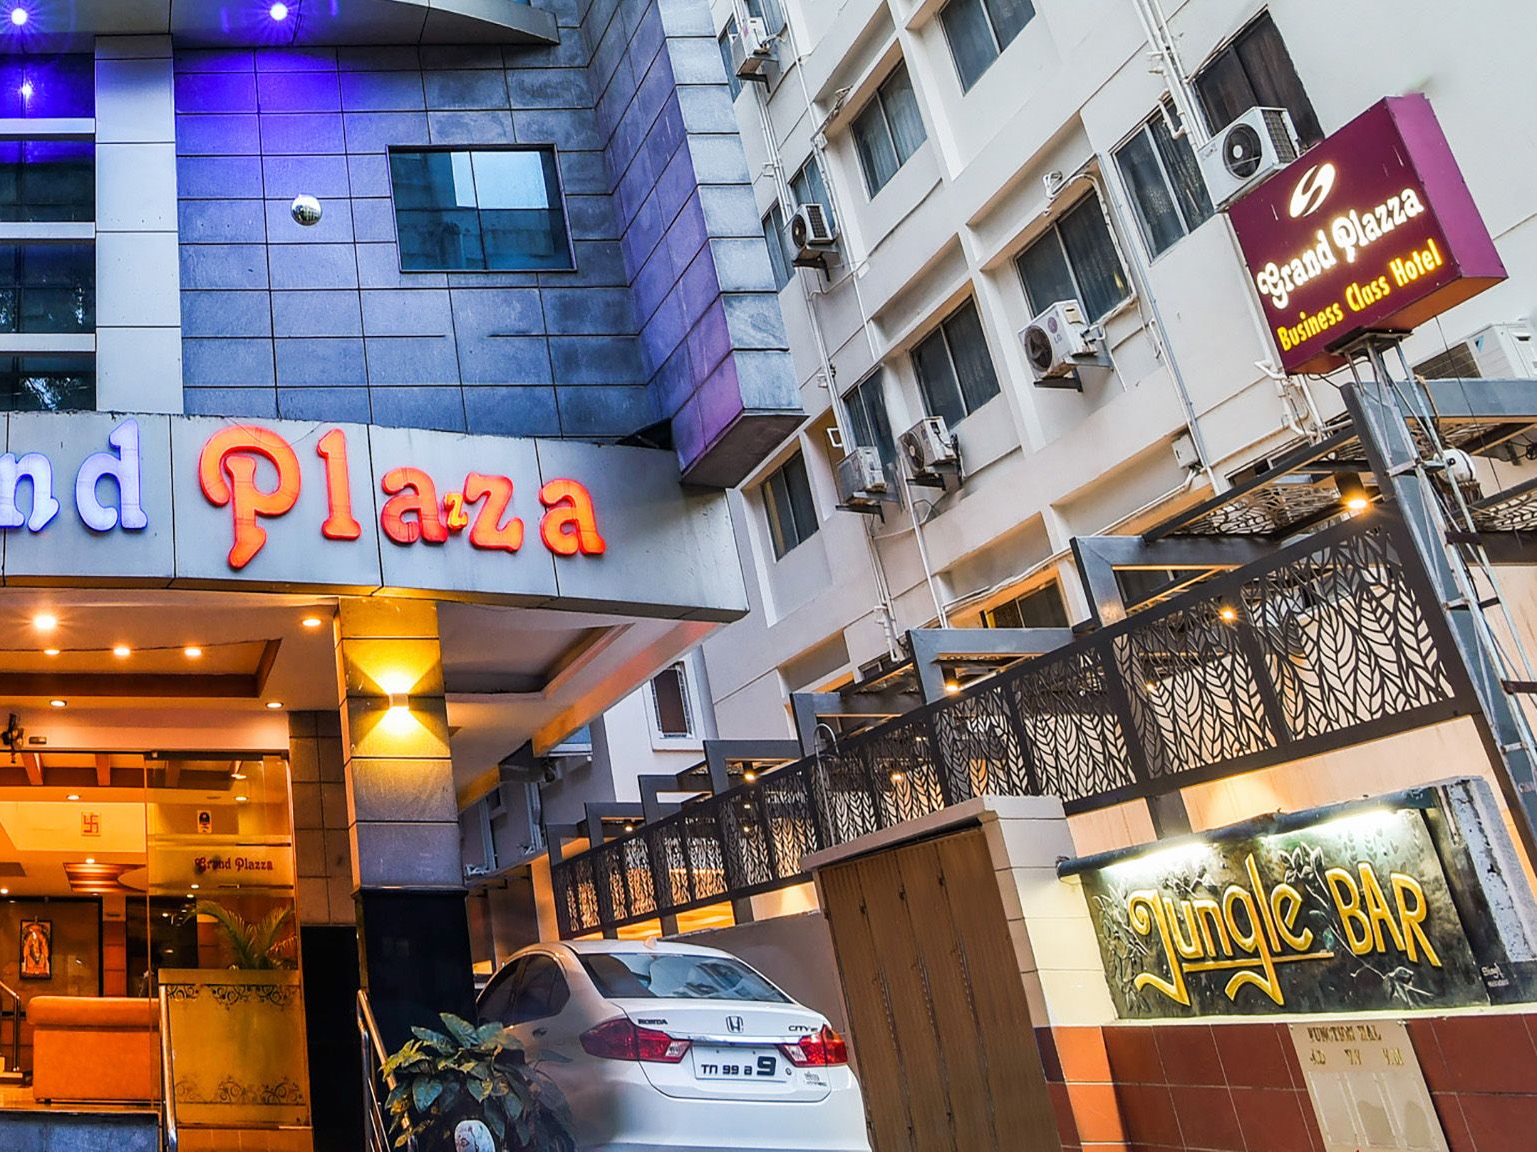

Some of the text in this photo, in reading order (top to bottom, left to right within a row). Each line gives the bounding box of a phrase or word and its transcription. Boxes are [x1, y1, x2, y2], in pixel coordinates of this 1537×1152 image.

[1256, 188, 1425, 309] Grand Plazza
[1277, 238, 1443, 352] Business Class Hotel
[194, 857, 273, 872] Grand Plazza
[1128, 852, 1442, 1007] Jungle BAR
[722, 1064, 740, 1076] 99
[756, 1055, 777, 1077] 9
